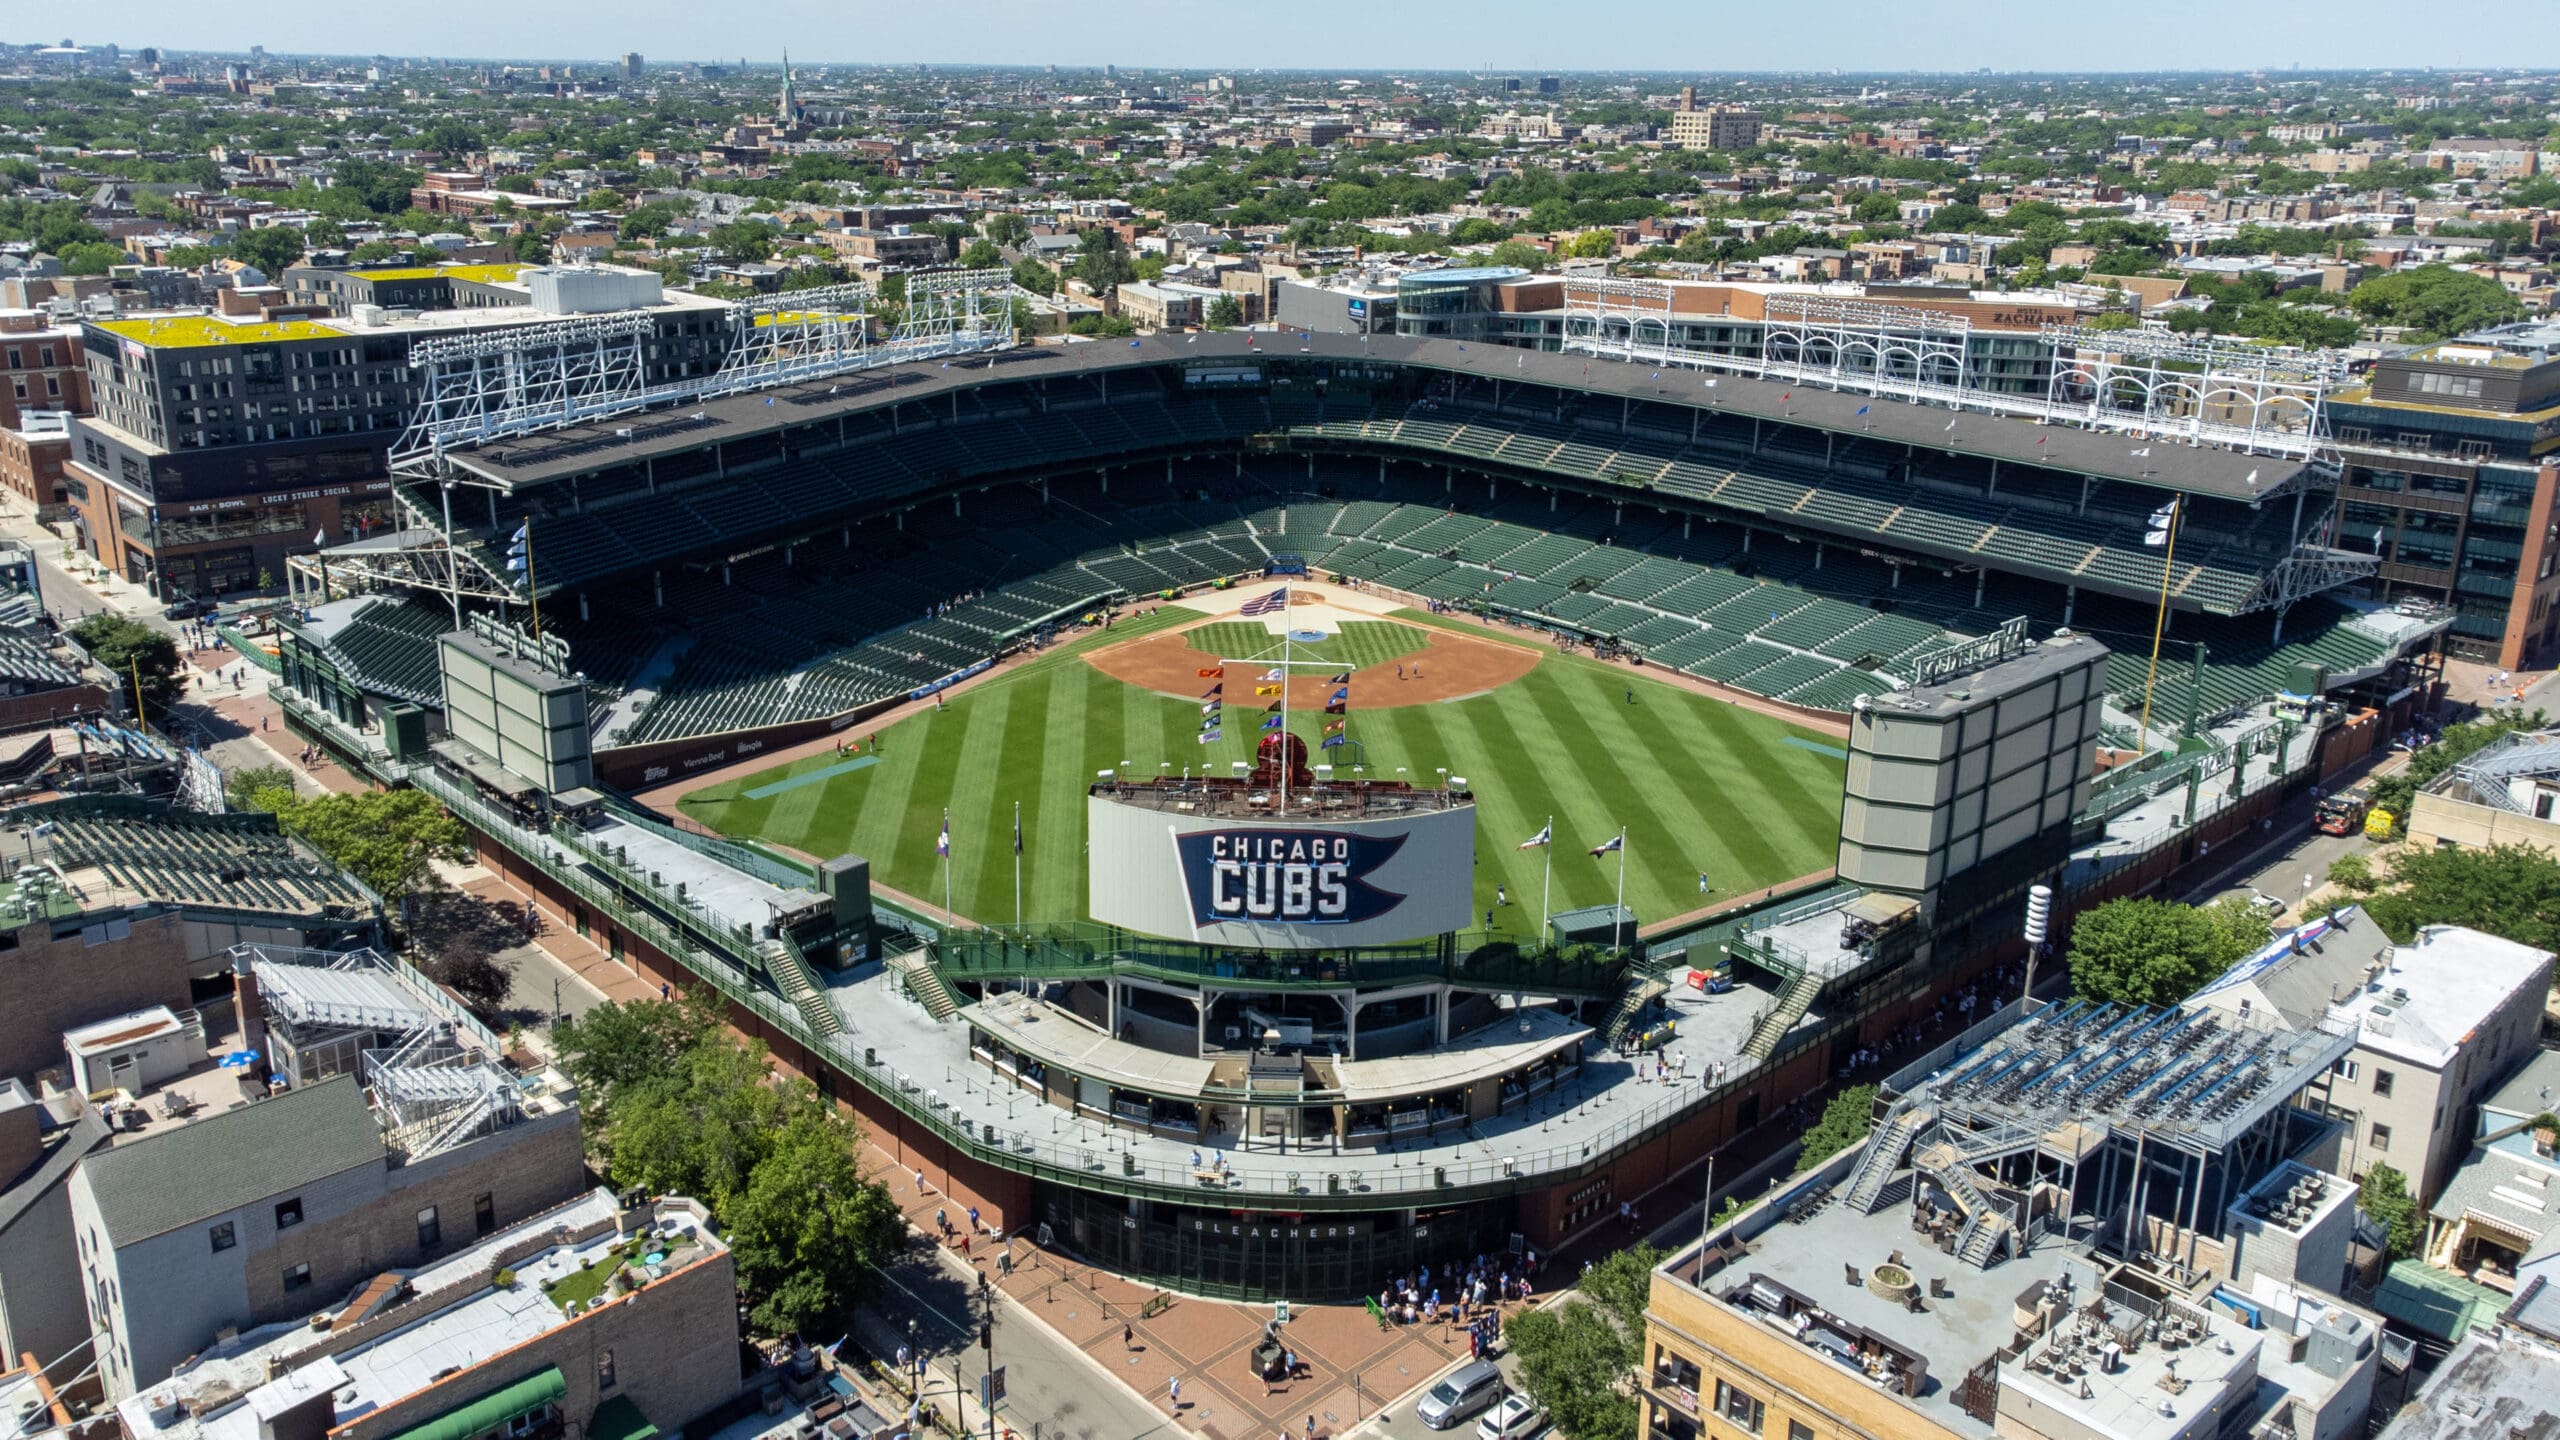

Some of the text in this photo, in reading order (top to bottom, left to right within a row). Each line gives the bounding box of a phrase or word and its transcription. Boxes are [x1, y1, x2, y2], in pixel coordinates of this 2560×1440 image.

[1993, 312, 2066, 325] ZACHARY
[262, 485, 351, 504] LUCKY STRIKE SOCIAL
[366, 482, 390, 491] FOOD
[189, 499, 246, 512] BAR BOWL
[1212, 835, 1348, 860] CHICAGO
[1212, 859, 1347, 915] CUBS
[1195, 1220, 1356, 1239] BLEACHERS
